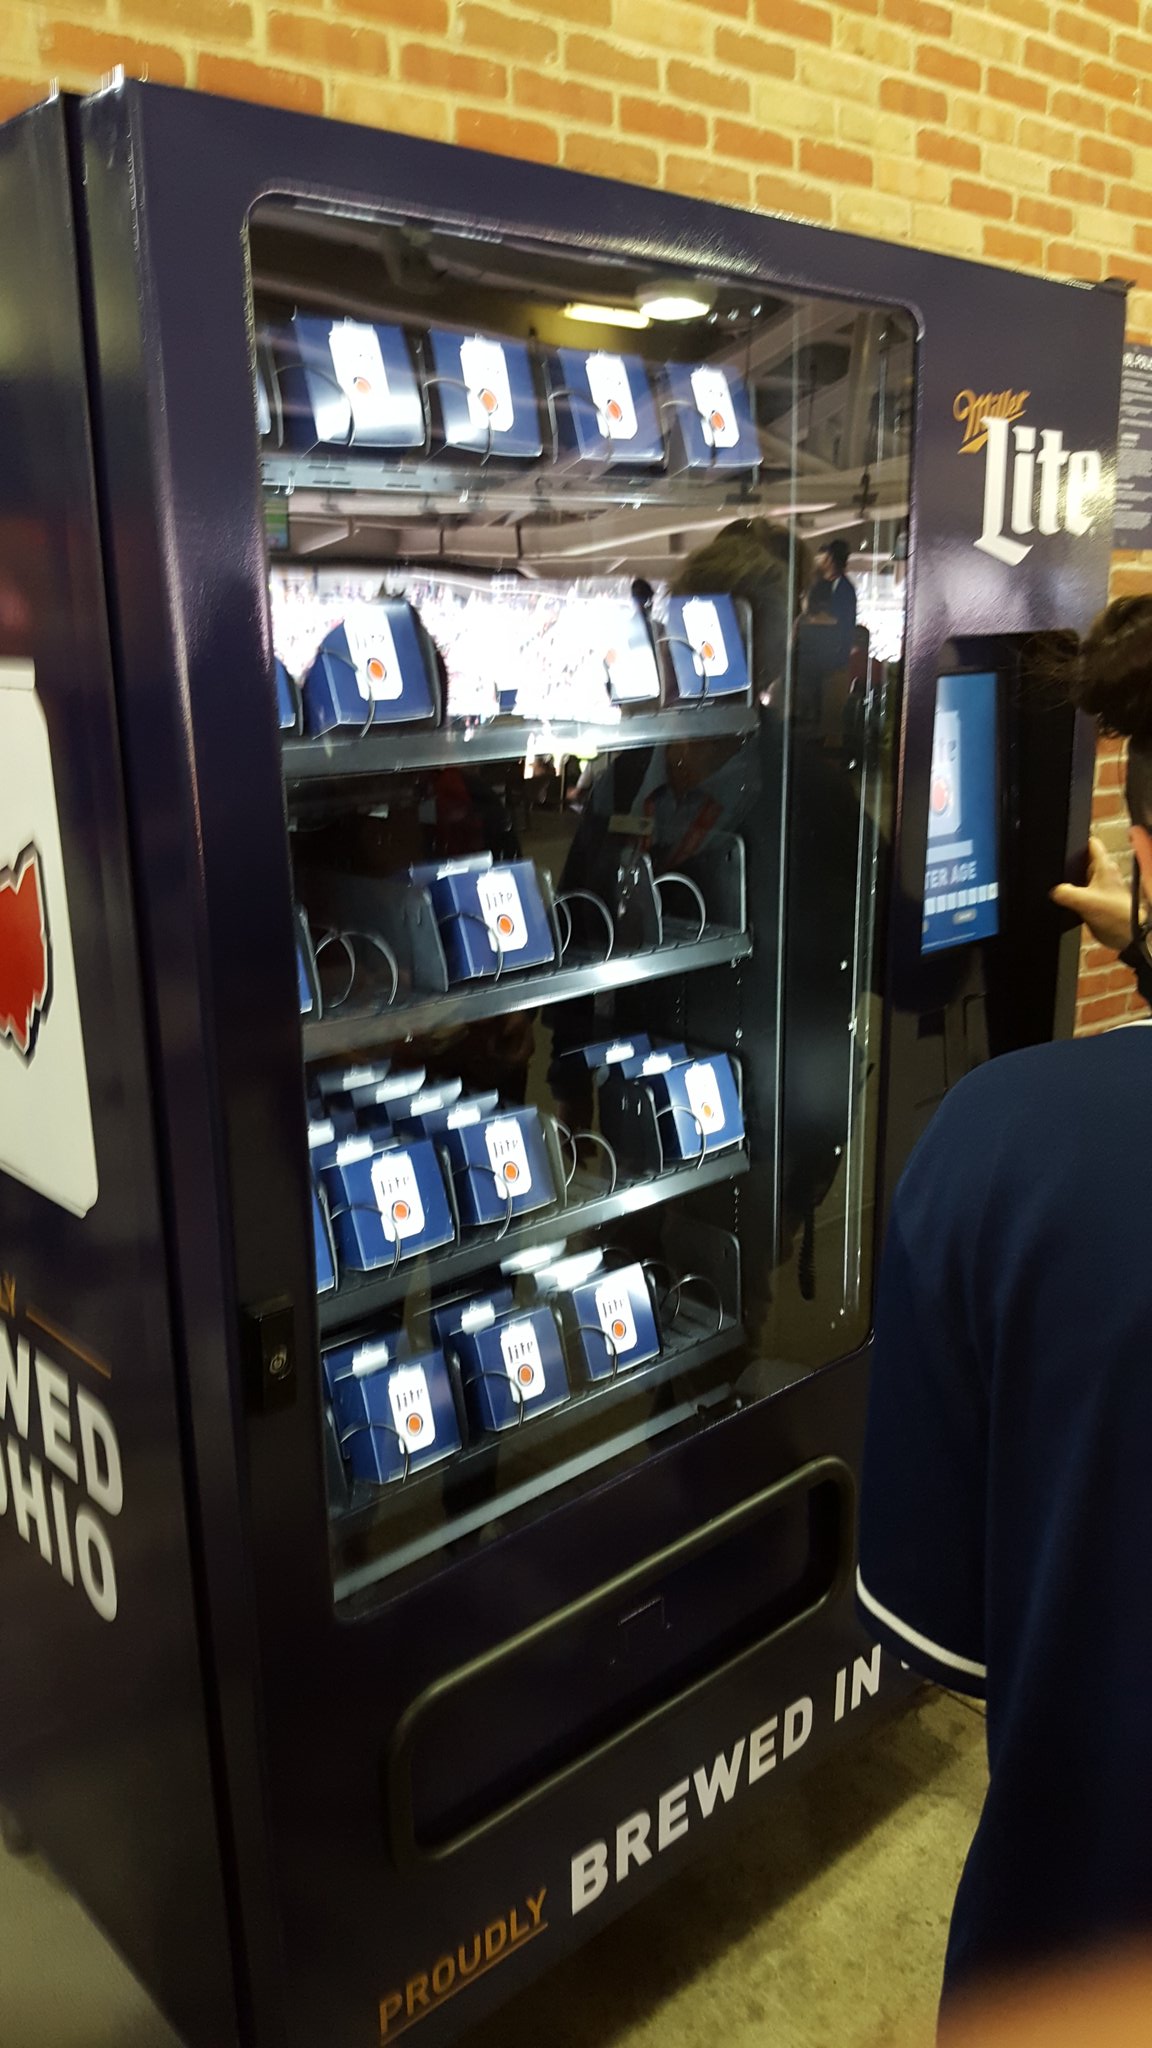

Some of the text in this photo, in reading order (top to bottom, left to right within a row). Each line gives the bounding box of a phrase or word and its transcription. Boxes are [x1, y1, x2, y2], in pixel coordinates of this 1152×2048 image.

[953, 388, 1031, 446] Miller
[973, 416, 1101, 567] Lite
[950, 860, 977, 884] AGE
[0, 1433, 117, 1622] HIO
[379, 1643, 881, 2034] PROUDLY BREWED IN
